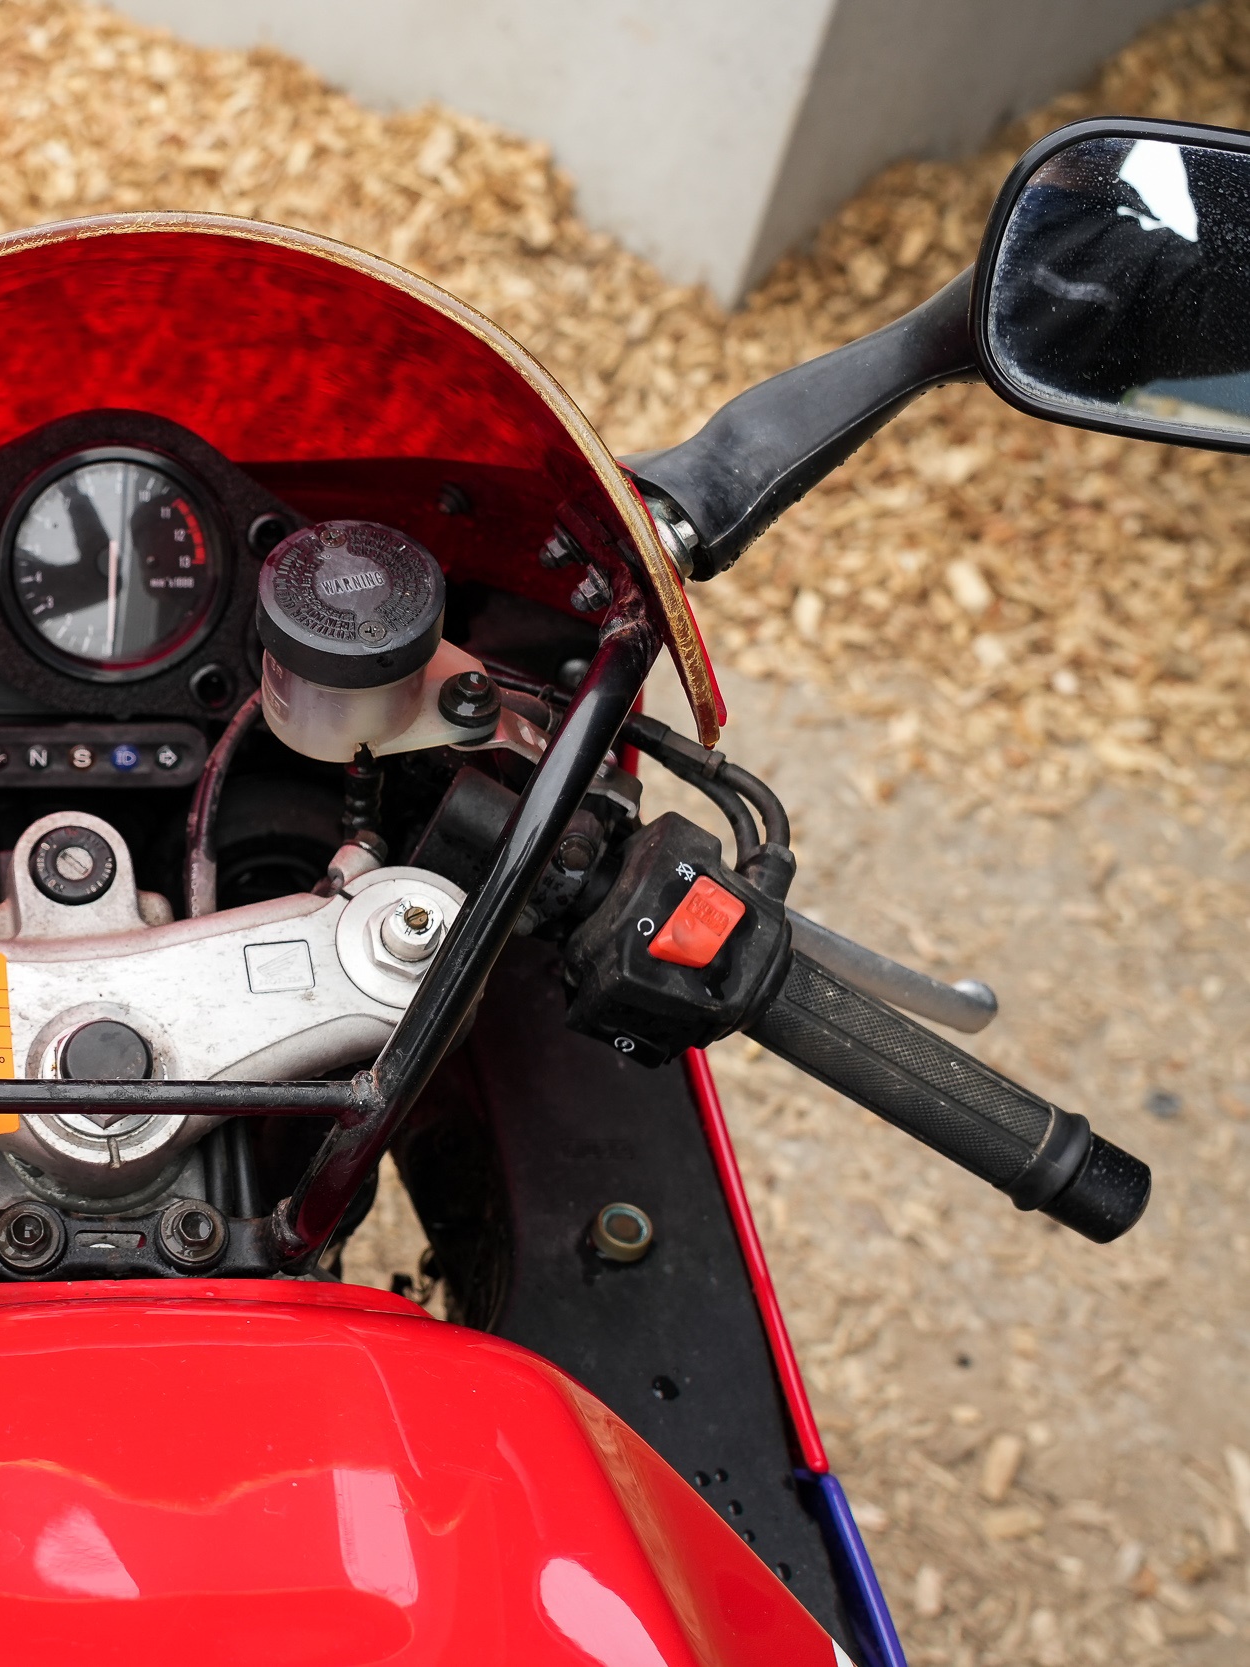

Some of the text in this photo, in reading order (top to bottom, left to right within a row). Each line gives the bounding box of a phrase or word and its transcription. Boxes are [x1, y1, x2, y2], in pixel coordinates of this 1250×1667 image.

[138, 489, 151, 503] 10
[160, 506, 172, 520] 11
[173, 529, 186, 543] 12
[178, 555, 191, 569] 13
[320, 571, 385, 596] WARNING
[29, 749, 48, 768] N
[72, 748, 93, 768] S
